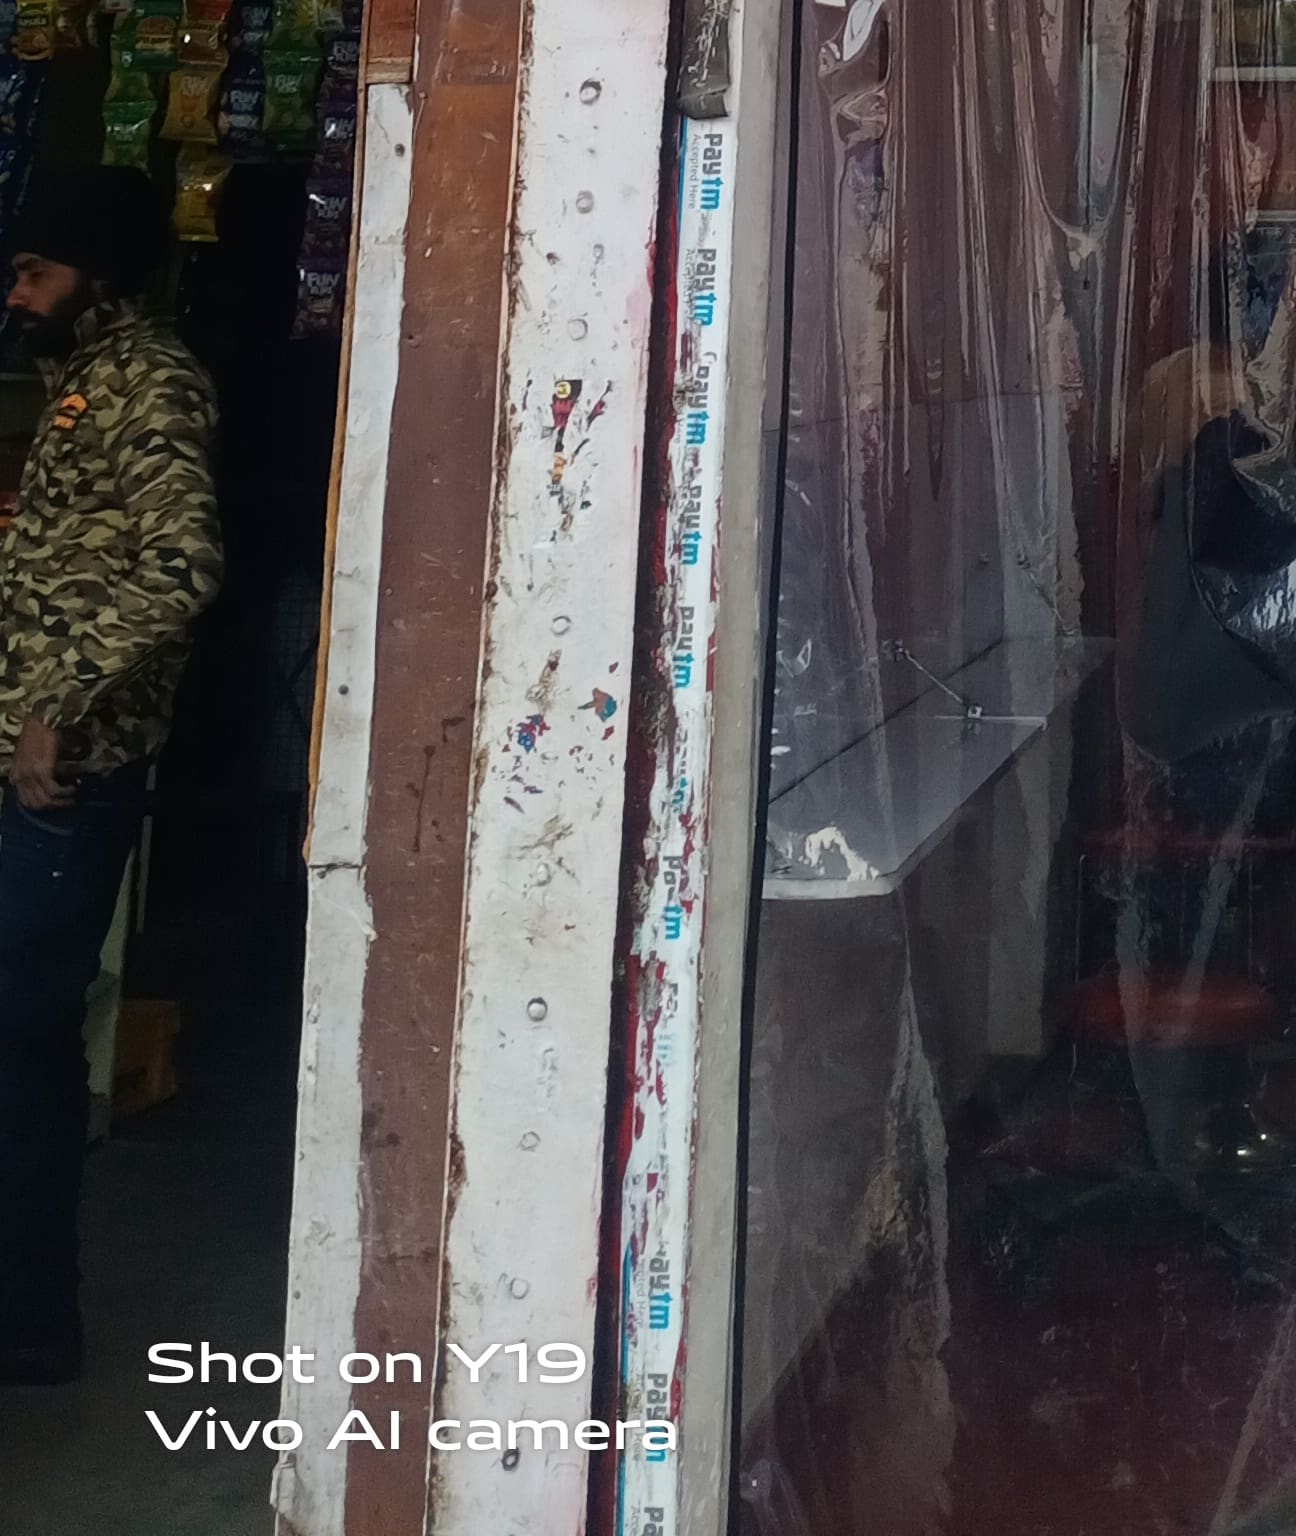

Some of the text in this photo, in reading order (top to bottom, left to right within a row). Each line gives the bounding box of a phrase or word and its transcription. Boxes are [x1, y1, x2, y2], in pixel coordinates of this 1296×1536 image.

[688, 134, 703, 209] Accepted Here
[701, 133, 724, 210] paytm
[694, 248, 719, 327] paytm
